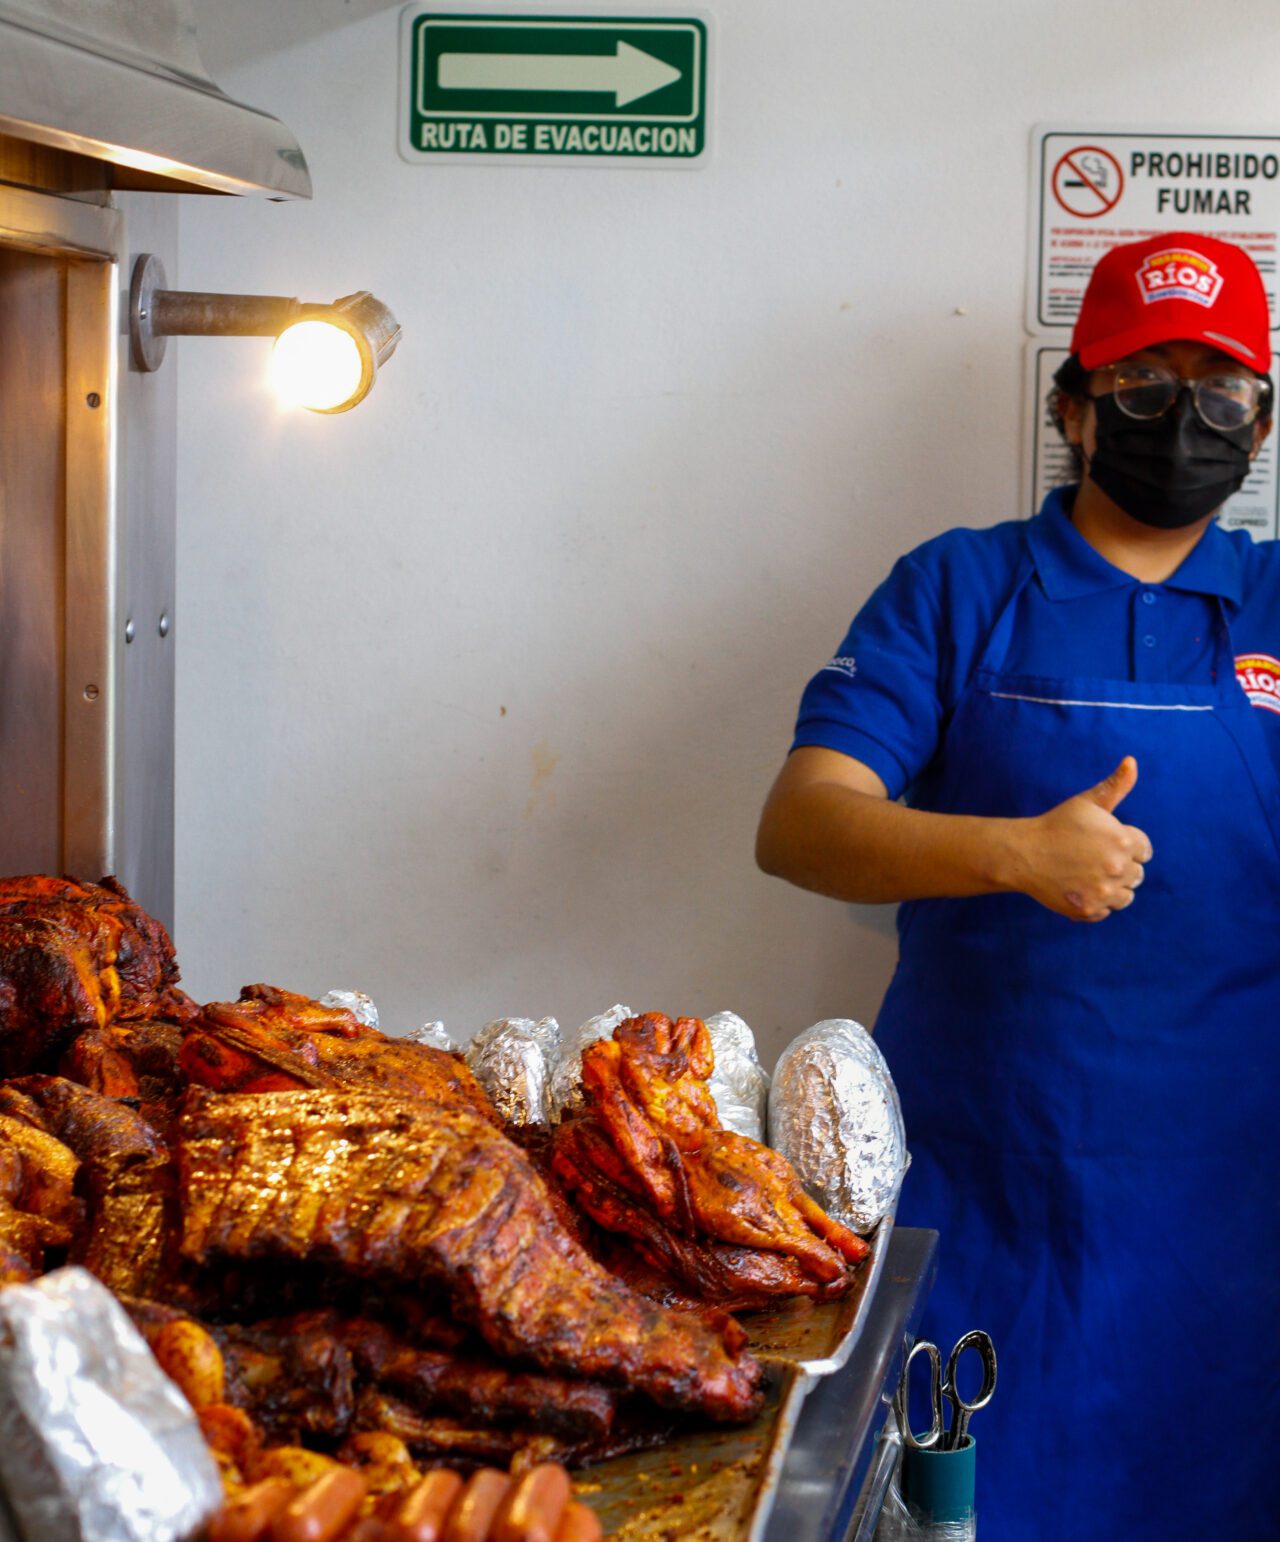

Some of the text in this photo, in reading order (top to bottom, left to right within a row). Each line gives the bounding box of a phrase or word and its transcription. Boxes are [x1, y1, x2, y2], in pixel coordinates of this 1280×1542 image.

[420, 122, 696, 153] RUTA DE EVACUACION
[1130, 151, 1280, 180] PROHIBIDO
[1156, 187, 1252, 215] FUMAR
[1145, 262, 1214, 293] RÍOS
